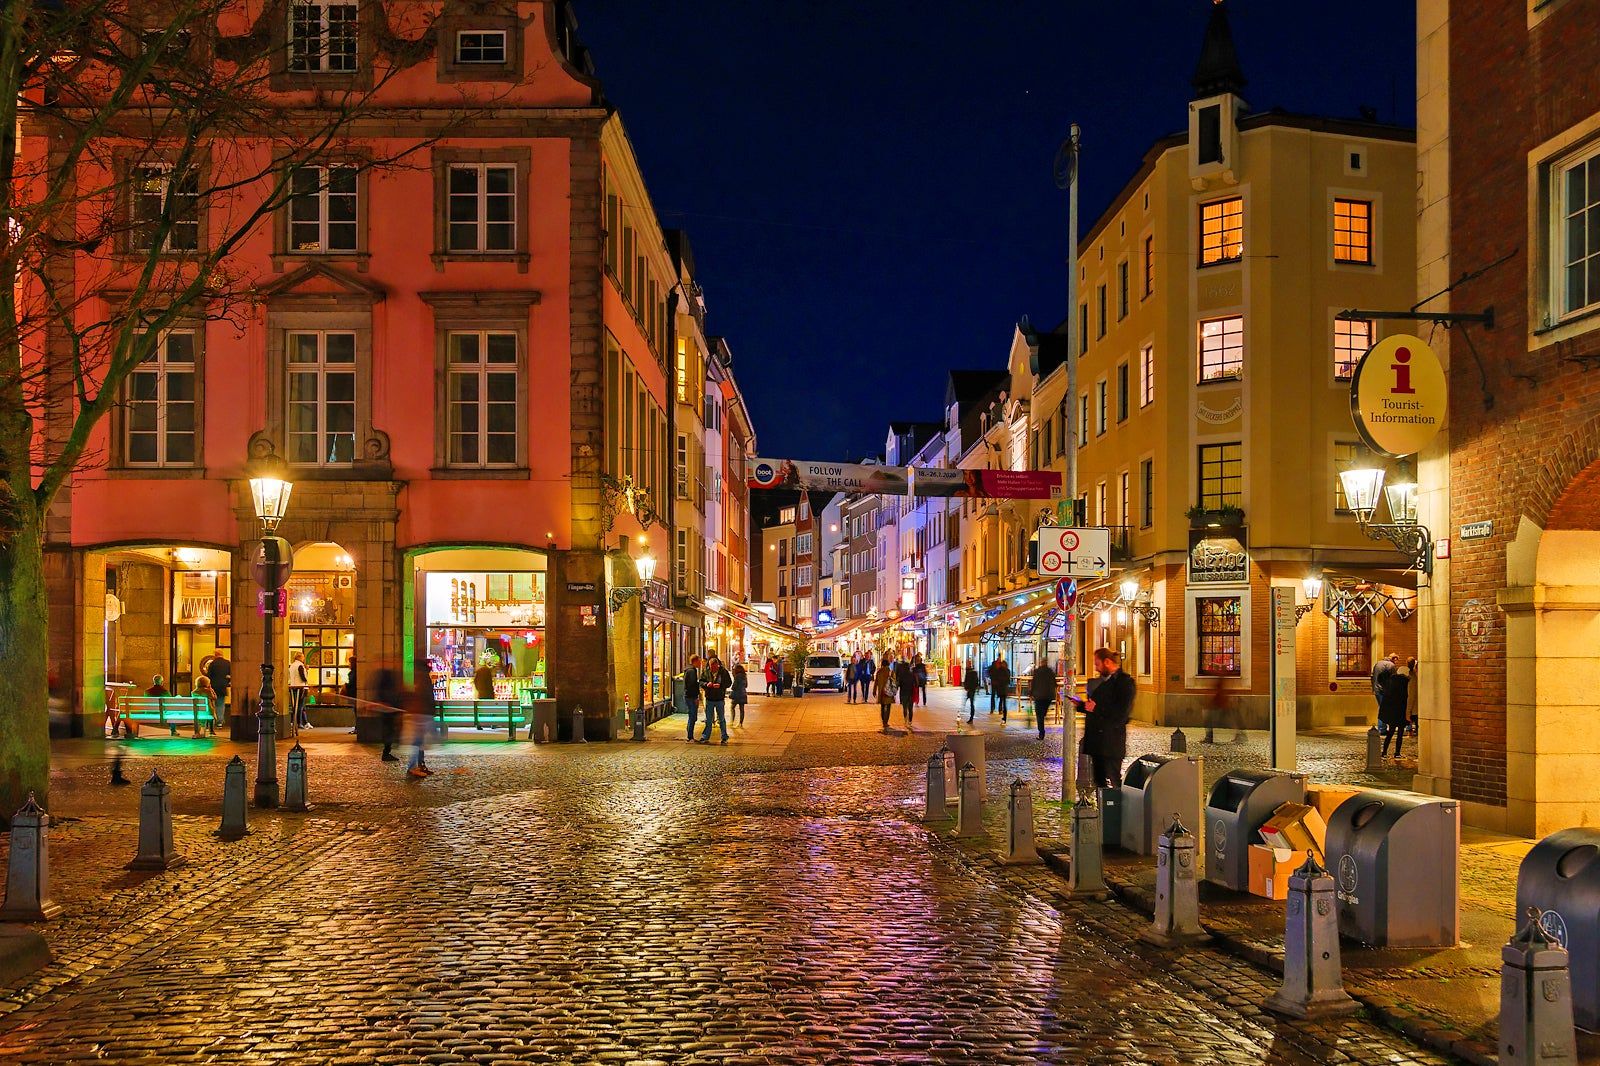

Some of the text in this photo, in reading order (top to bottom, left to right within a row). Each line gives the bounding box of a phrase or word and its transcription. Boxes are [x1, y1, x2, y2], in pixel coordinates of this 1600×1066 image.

[1381, 398, 1424, 410] Tourist-
[1370, 412, 1436, 425] Information
[809, 466, 842, 476] FOLLOW
[826, 477, 866, 488] THE CALL.
